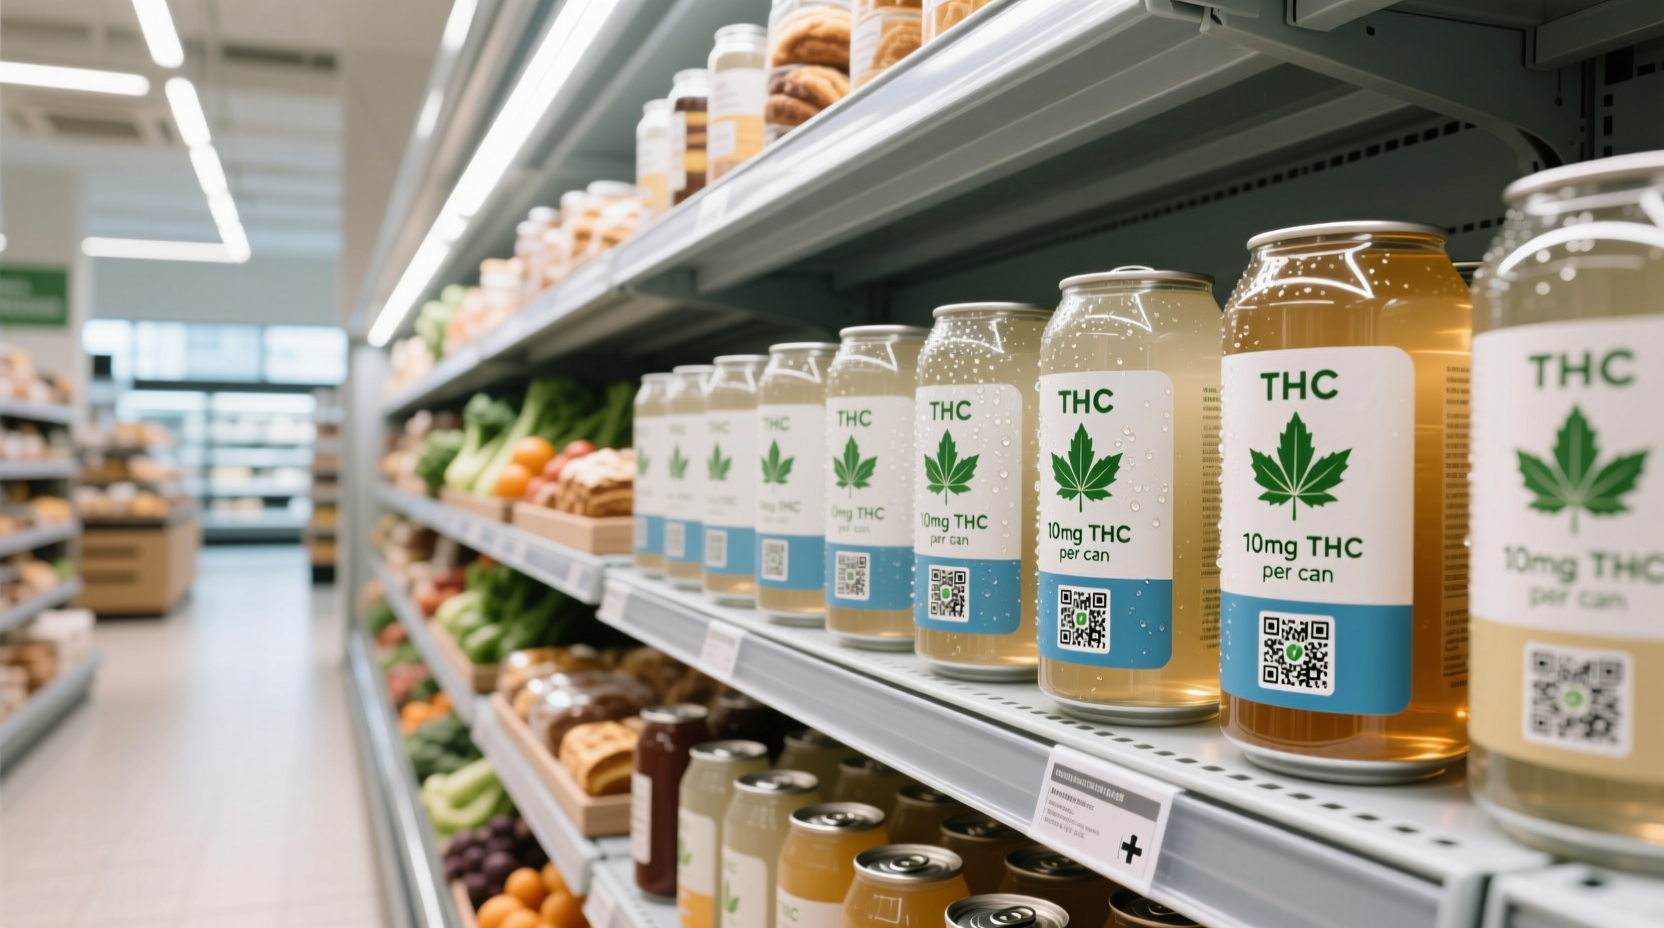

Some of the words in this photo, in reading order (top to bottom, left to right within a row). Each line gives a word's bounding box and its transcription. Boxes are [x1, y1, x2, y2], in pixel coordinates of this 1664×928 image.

[1529, 349, 1635, 388] THC
[1260, 369, 1339, 401] THC
[929, 399, 972, 421] THC
[1058, 388, 1114, 414] THC
[762, 417, 790, 431] THC
[836, 410, 872, 427] THC
[857, 507, 886, 520] THC
[920, 512, 949, 532] 10mg
[953, 514, 988, 530] THC
[949, 536, 968, 546] can
[1047, 522, 1083, 545] 10mg
[1088, 524, 1131, 543] THC
[1059, 548, 1079, 562] per
[1083, 549, 1110, 562] can
[1243, 533, 1298, 560] 10mg
[1306, 536, 1363, 559] THC
[1263, 565, 1291, 582] per
[1298, 566, 1334, 583] can
[1503, 546, 1578, 584] 10mg
[1589, 551, 1664, 584] THC
[1528, 587, 1569, 609] per
[1575, 590, 1629, 612] can
